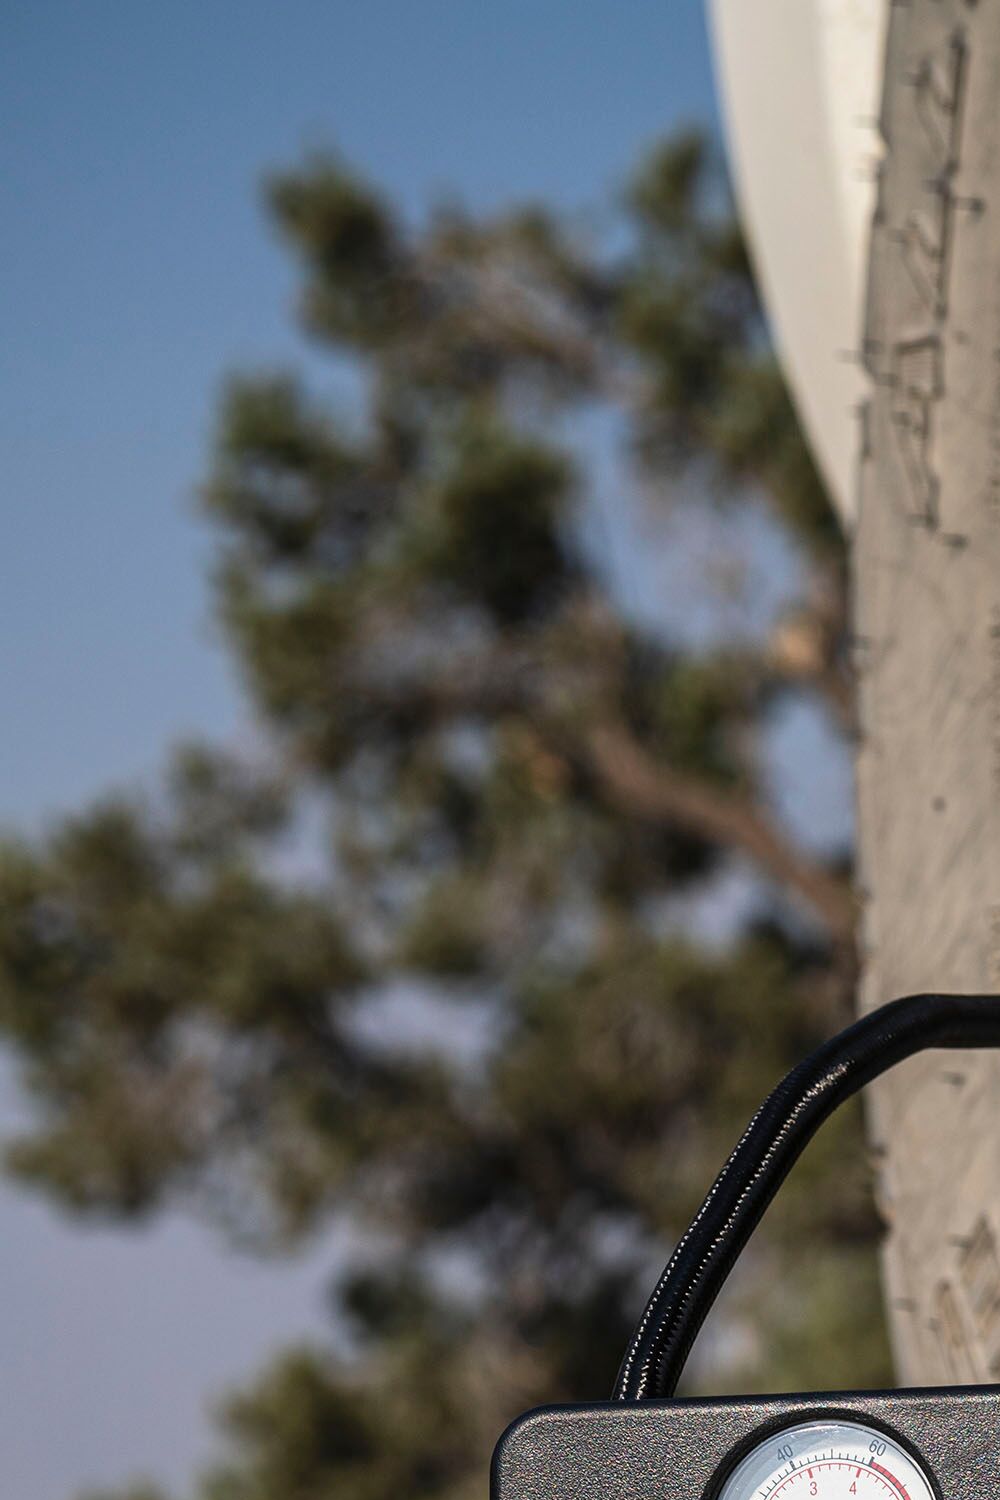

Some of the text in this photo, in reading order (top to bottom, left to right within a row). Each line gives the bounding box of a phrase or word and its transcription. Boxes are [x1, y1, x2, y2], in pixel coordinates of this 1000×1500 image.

[777, 1444, 794, 1461] 40
[869, 1439, 887, 1457] 60
[809, 1481, 818, 1496] 3
[848, 1481, 857, 1495] 4
